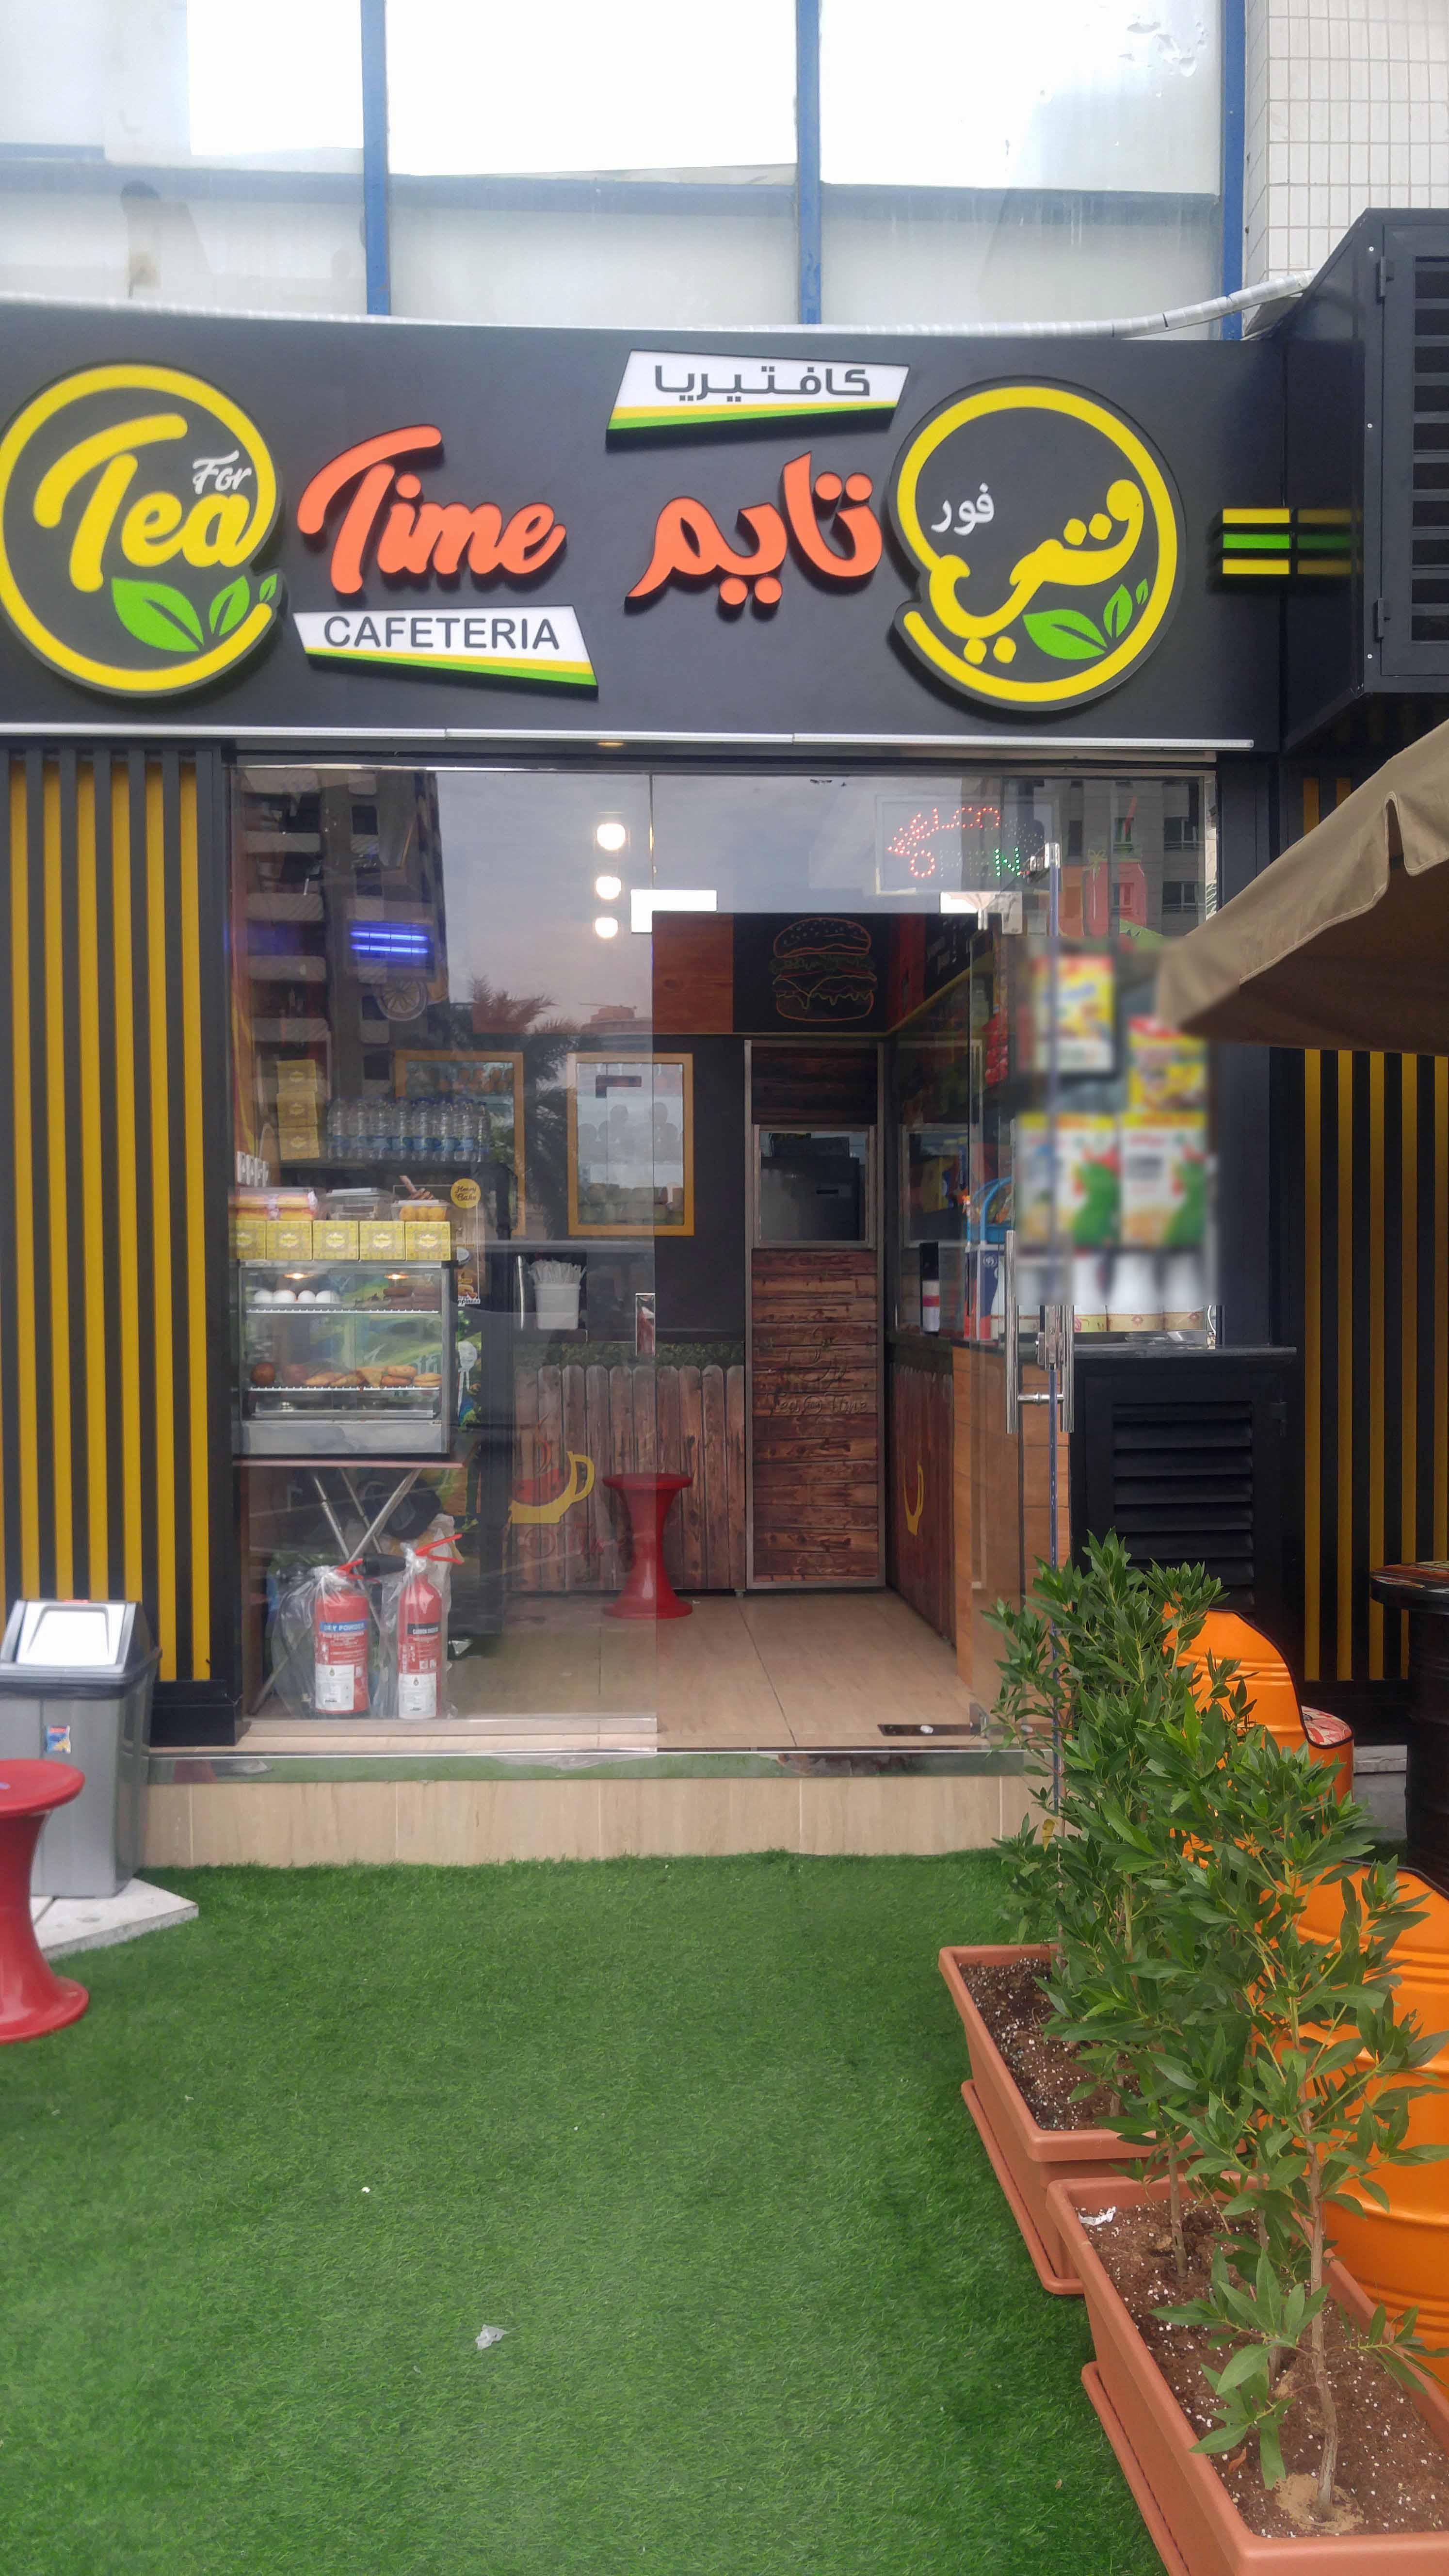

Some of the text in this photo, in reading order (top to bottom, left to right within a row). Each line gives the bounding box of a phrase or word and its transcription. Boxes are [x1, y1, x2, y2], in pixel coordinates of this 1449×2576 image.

[654, 365, 871, 402] كافتيريا
[33, 413, 566, 595] Tea For Time
[627, 452, 883, 606] تايم
[931, 483, 994, 535] فور
[323, 616, 560, 650] CAFETERIA
